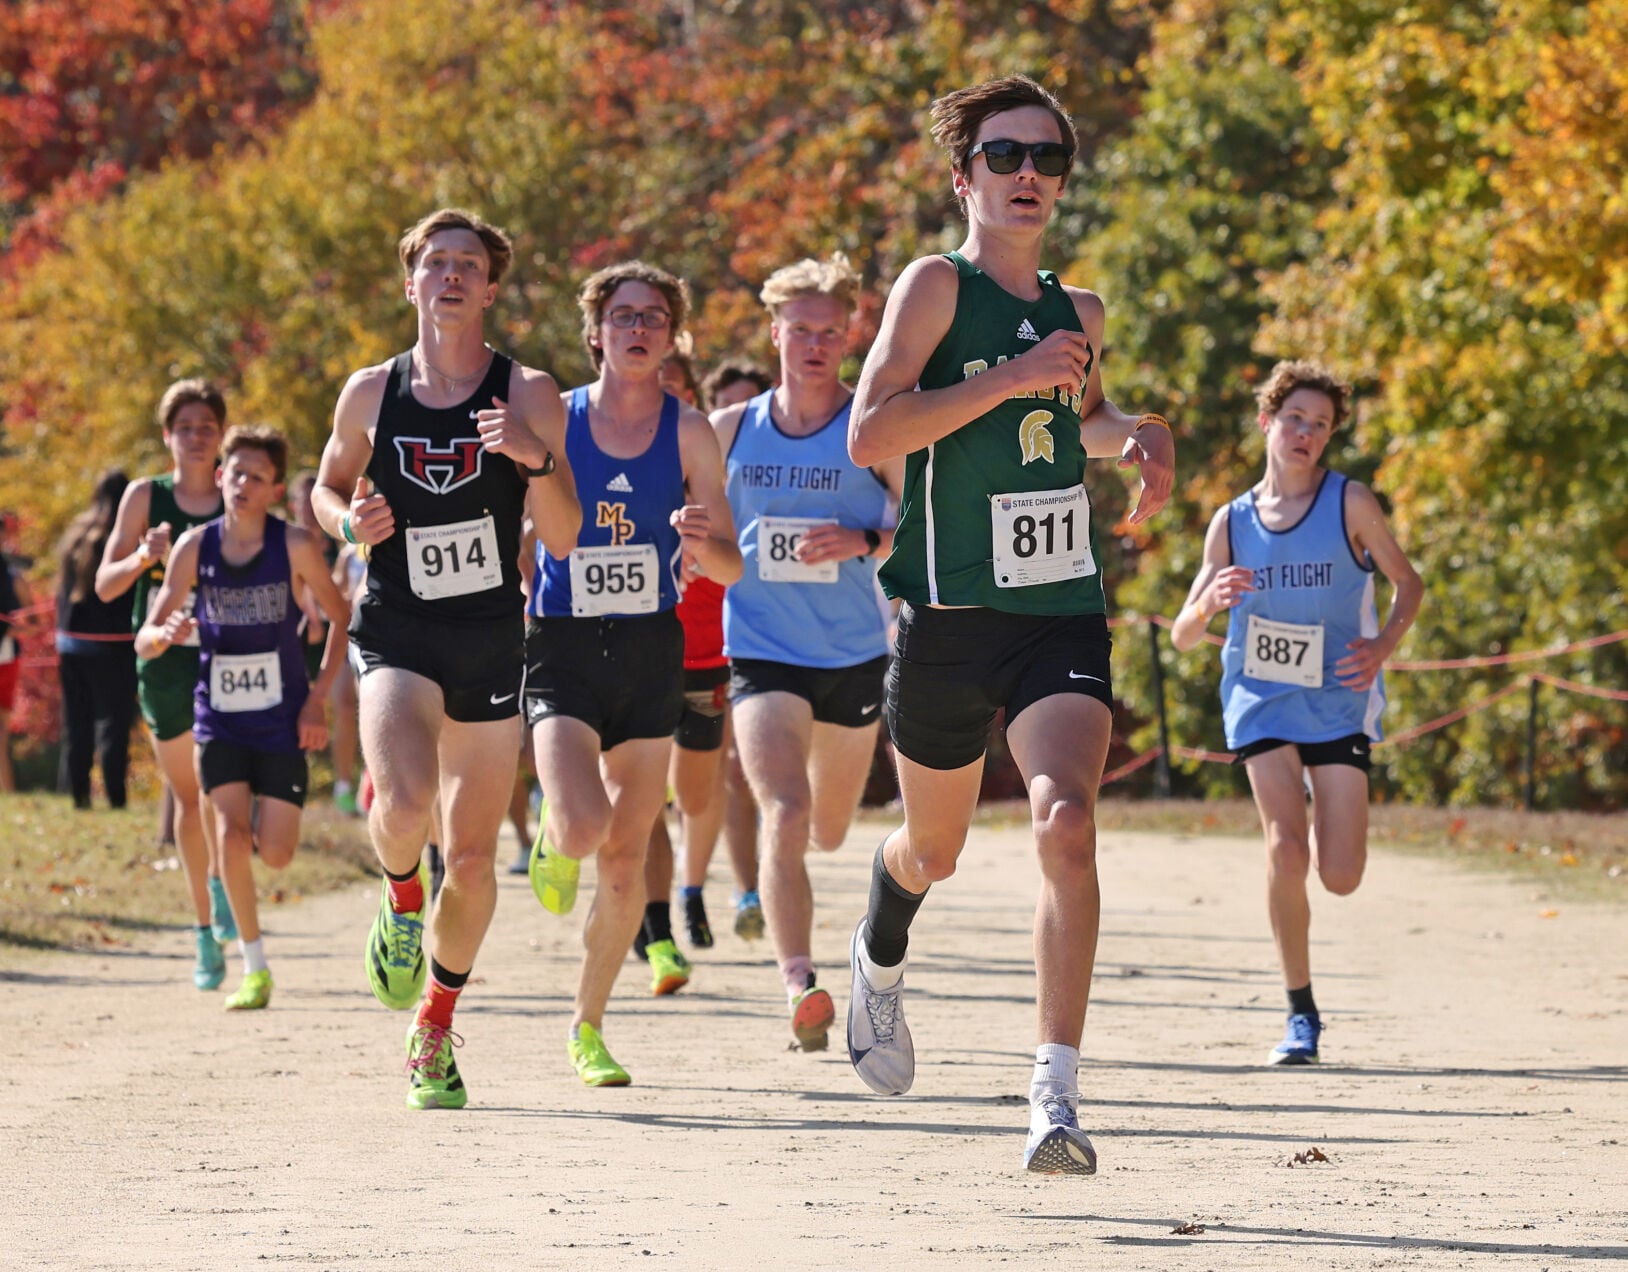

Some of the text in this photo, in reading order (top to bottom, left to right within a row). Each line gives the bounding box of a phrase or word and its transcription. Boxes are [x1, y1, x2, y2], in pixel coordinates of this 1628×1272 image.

[1016, 332, 1041, 342] adidas
[742, 465, 841, 491] FIRST FLIGHT
[1013, 493, 1078, 508] STATE CHAMPIONSHIP
[1012, 508, 1074, 558] 811
[421, 536, 486, 577] 914
[585, 562, 645, 595] 955
[1281, 563, 1333, 588] FLIGHT
[1256, 634, 1310, 667] 887
[220, 668, 268, 694] 844
